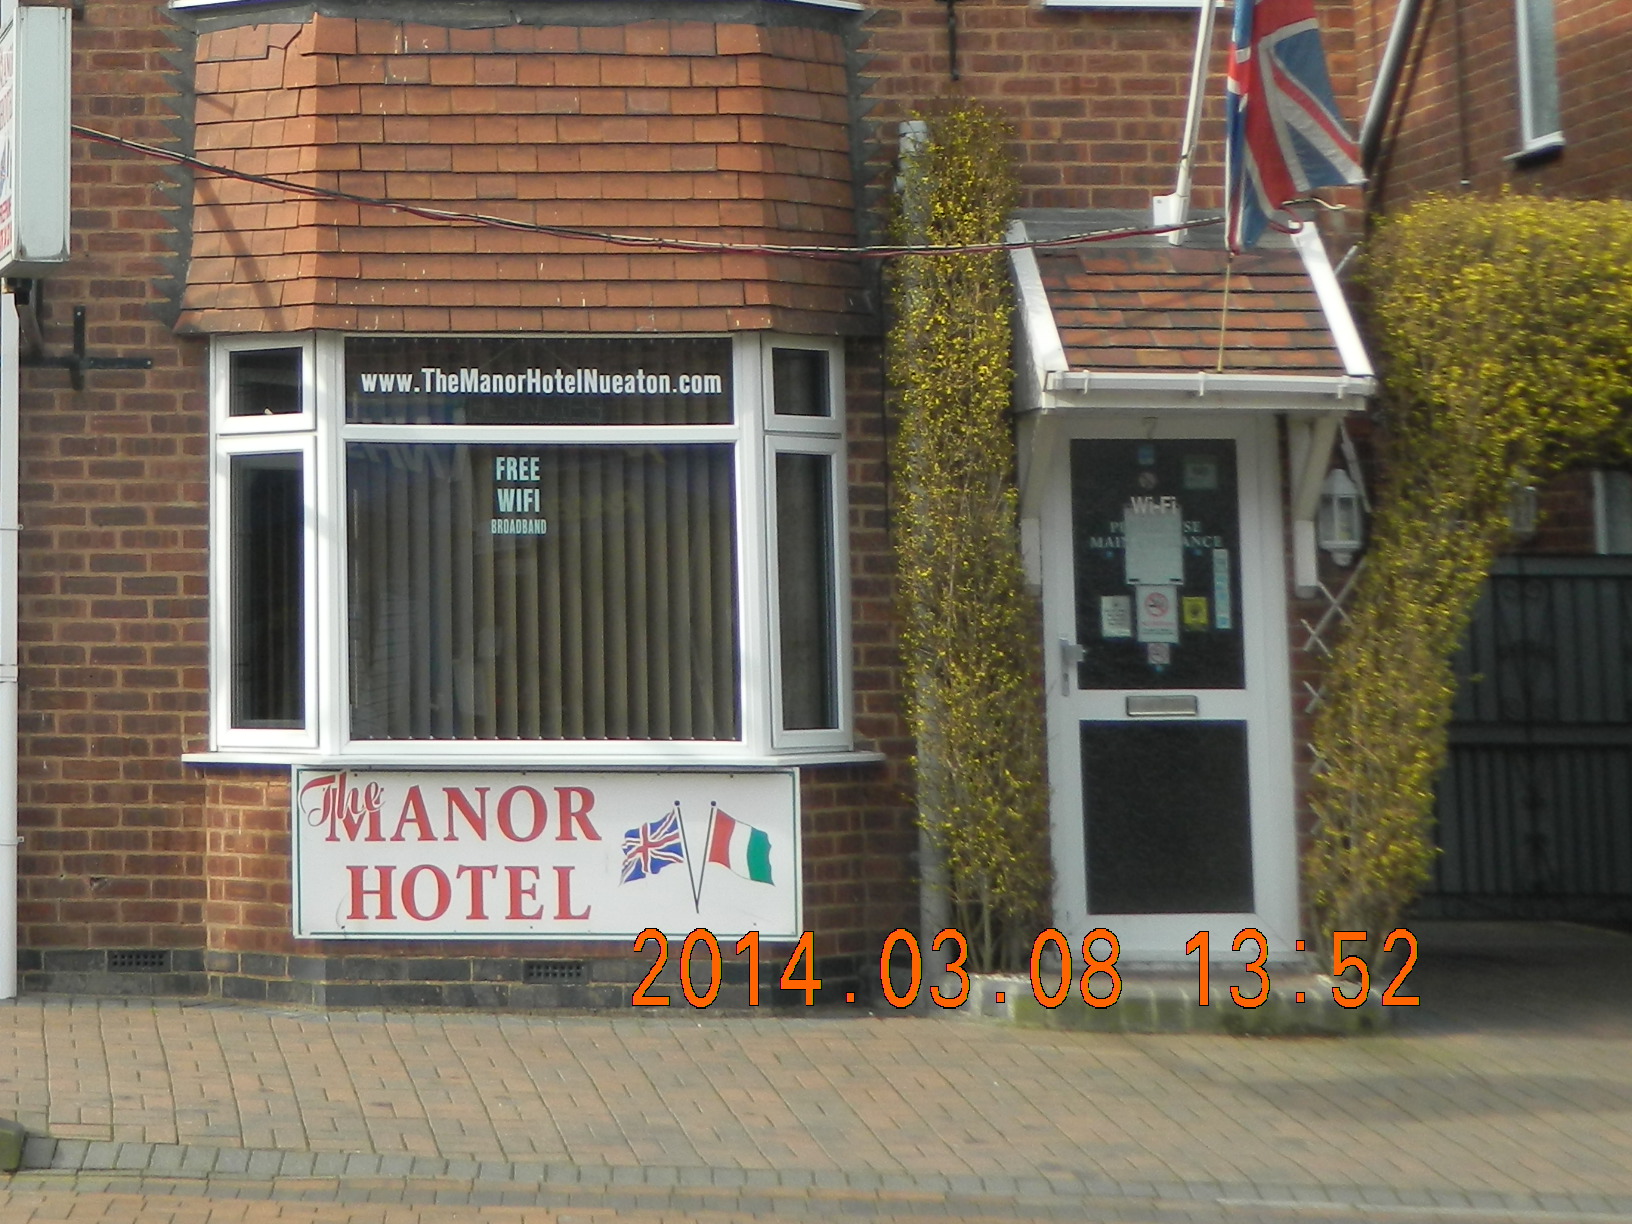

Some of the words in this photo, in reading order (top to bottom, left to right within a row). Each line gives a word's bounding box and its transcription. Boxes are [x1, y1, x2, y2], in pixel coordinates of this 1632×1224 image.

[361, 367, 722, 395] www.TheManorHotelNueaton.com
[496, 456, 541, 482] FREE
[497, 488, 541, 513] WIFI
[490, 518, 547, 536] BROADBAND
[300, 771, 387, 827] The
[325, 784, 602, 843] MANOR
[345, 863, 593, 922] HOTEL
